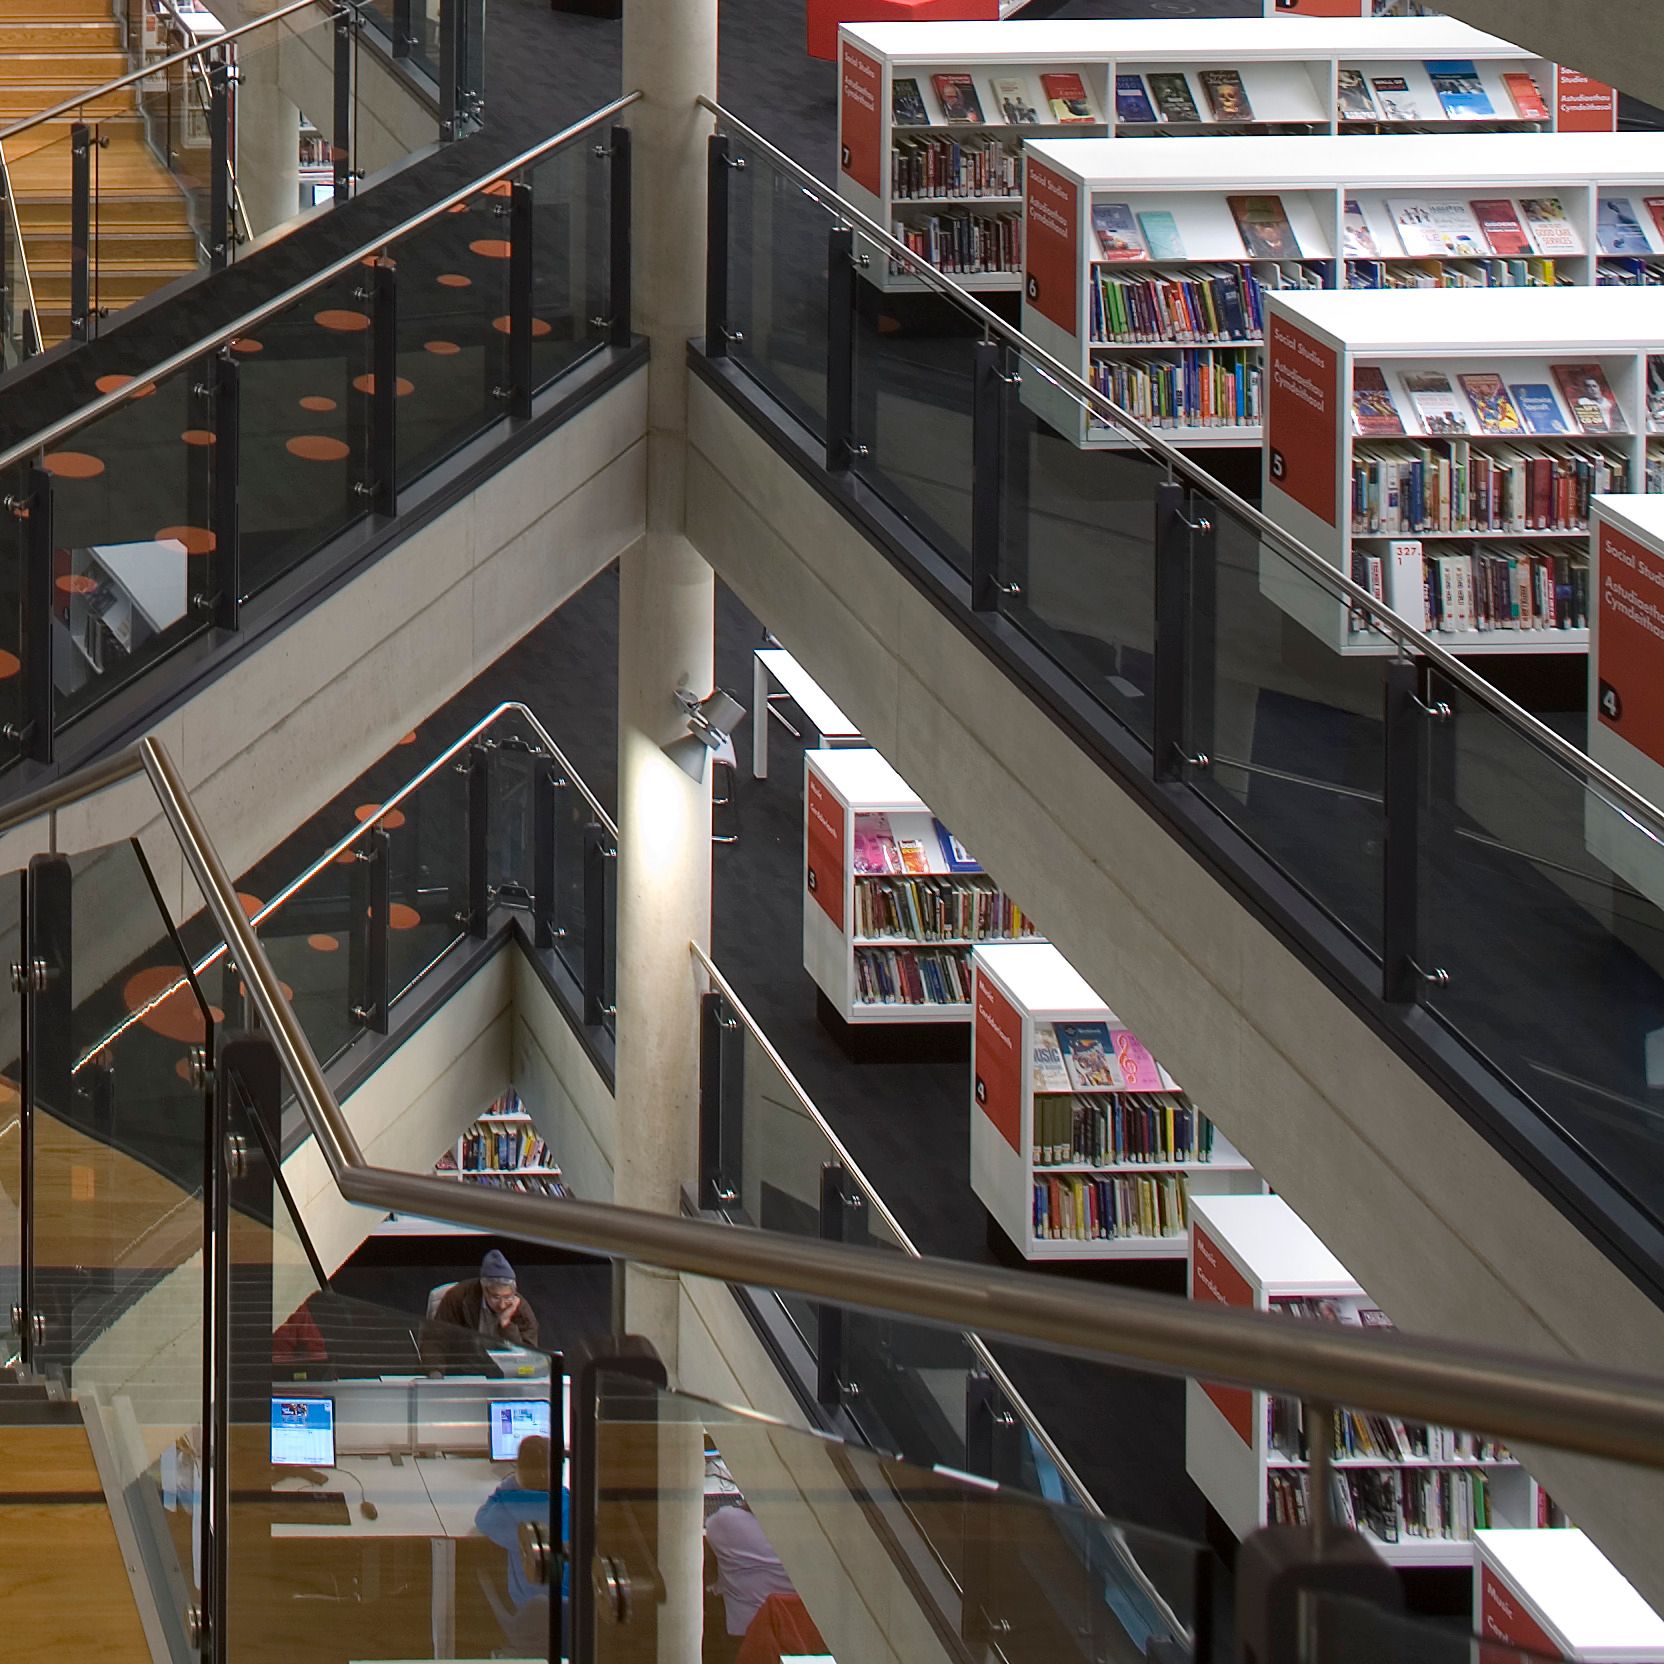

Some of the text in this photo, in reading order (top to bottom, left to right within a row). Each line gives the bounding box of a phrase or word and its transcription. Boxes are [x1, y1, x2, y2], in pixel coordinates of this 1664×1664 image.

[842, 147, 850, 165] 7
[1029, 169, 1069, 201] Social Studies
[1029, 279, 1037, 297] 6
[1274, 328, 1325, 369] Social Studies
[1274, 358, 1324, 399] Astudiaethau
[1274, 371, 1324, 413] Cymdeithasol
[1273, 453, 1283, 477] 5
[1396, 547, 1421, 556] 327.
[1398, 557, 1402, 566] 1
[1604, 539, 1636, 569] Social
[1603, 689, 1617, 716] 4
[809, 870, 816, 889] 5
[979, 980, 994, 1004] Music
[977, 1085, 985, 1101] 4
[1197, 1239, 1217, 1268] Music
[1487, 1582, 1513, 1620] Music
